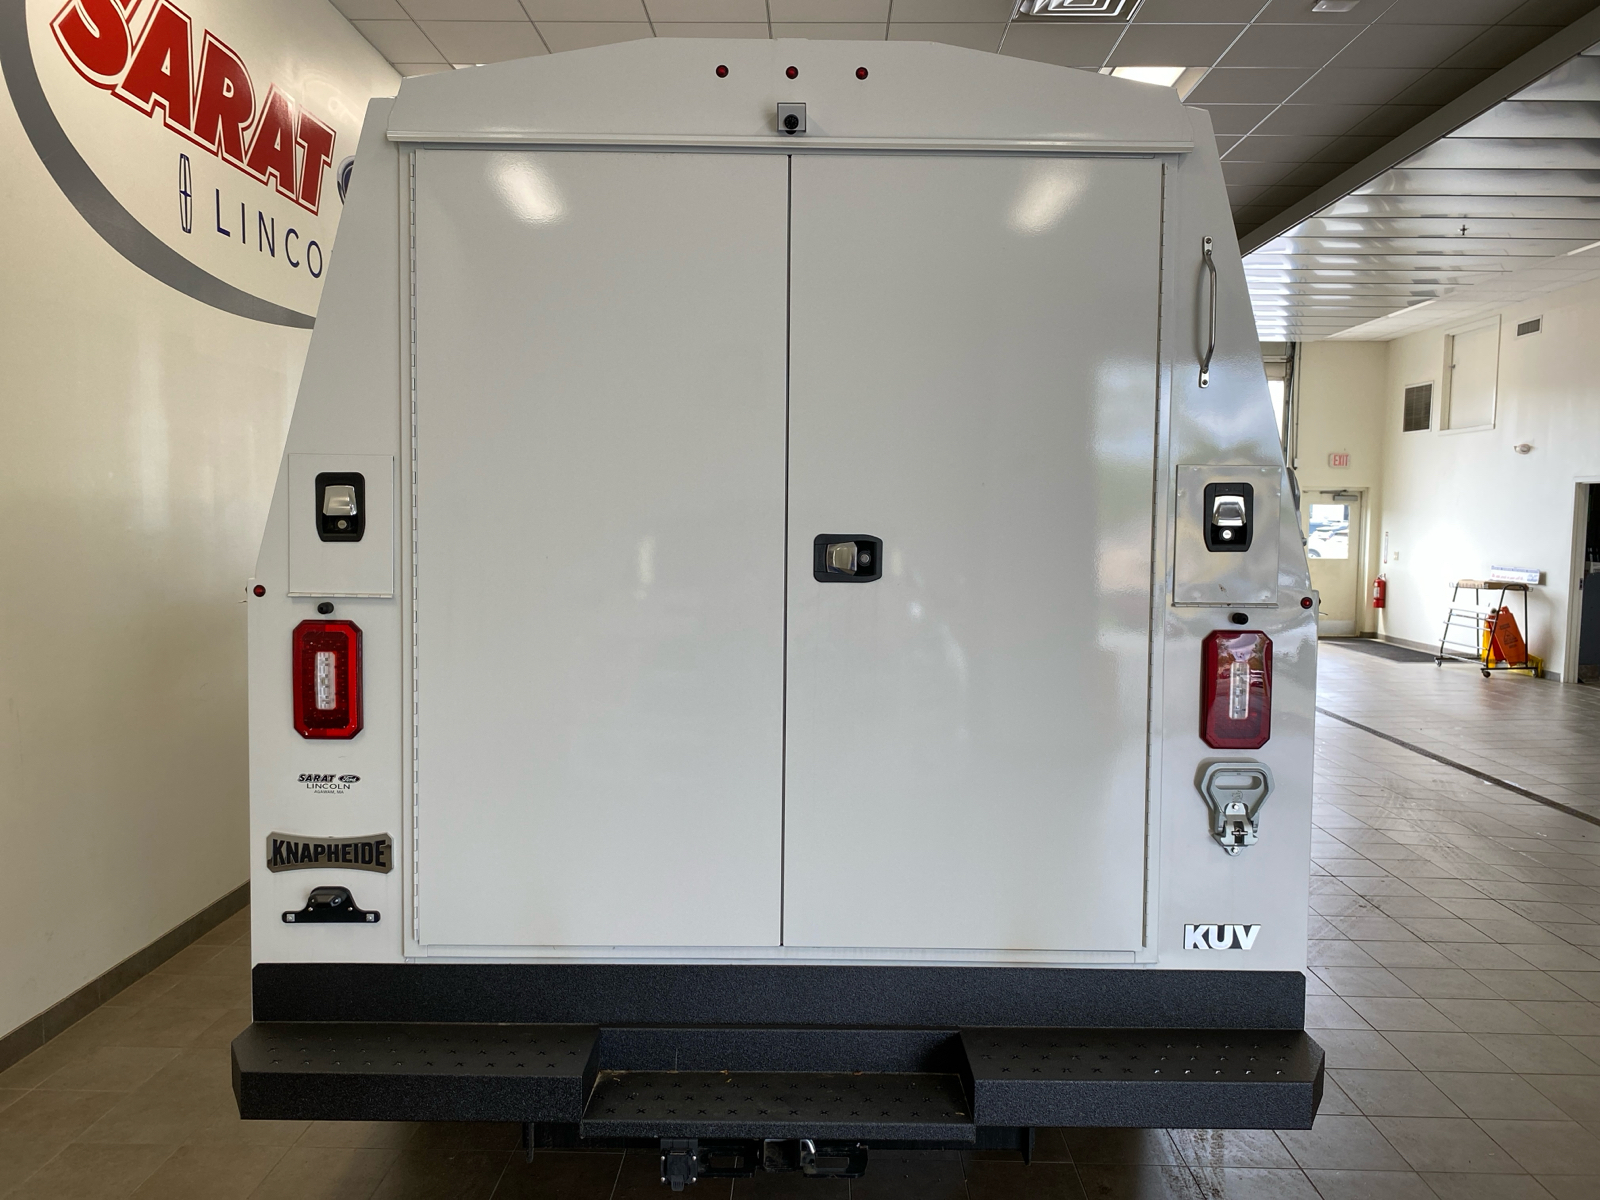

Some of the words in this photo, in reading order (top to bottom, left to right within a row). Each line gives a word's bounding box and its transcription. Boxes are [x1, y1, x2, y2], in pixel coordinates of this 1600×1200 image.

[50, 0, 336, 216] SARAT
[1333, 454, 1349, 467] EXIT
[298, 774, 336, 783] SARAT
[272, 838, 387, 868] KNAPHEIDE
[1183, 923, 1261, 950] KUV
